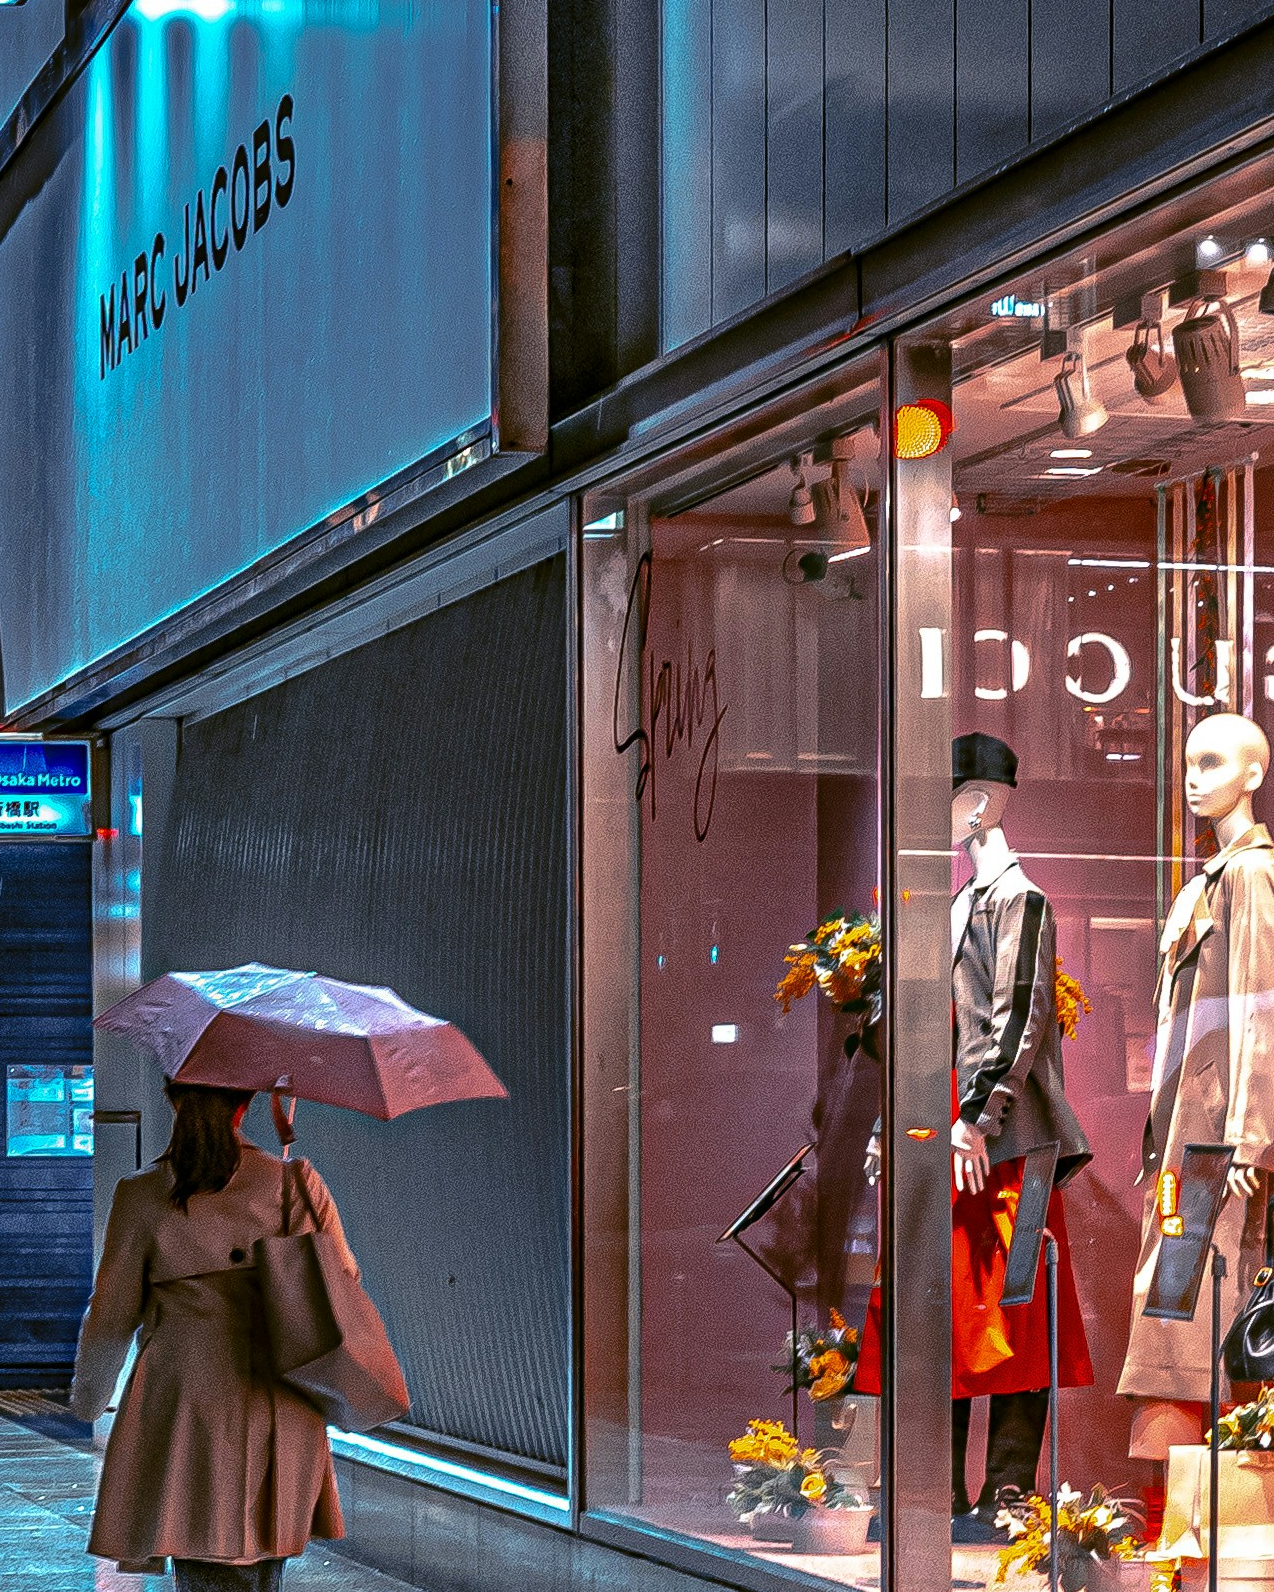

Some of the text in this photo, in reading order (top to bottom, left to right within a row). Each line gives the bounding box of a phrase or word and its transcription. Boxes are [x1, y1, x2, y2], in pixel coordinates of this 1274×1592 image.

[99, 93, 296, 381] MARC JACOBS
[37, 773, 81, 786] Metro
